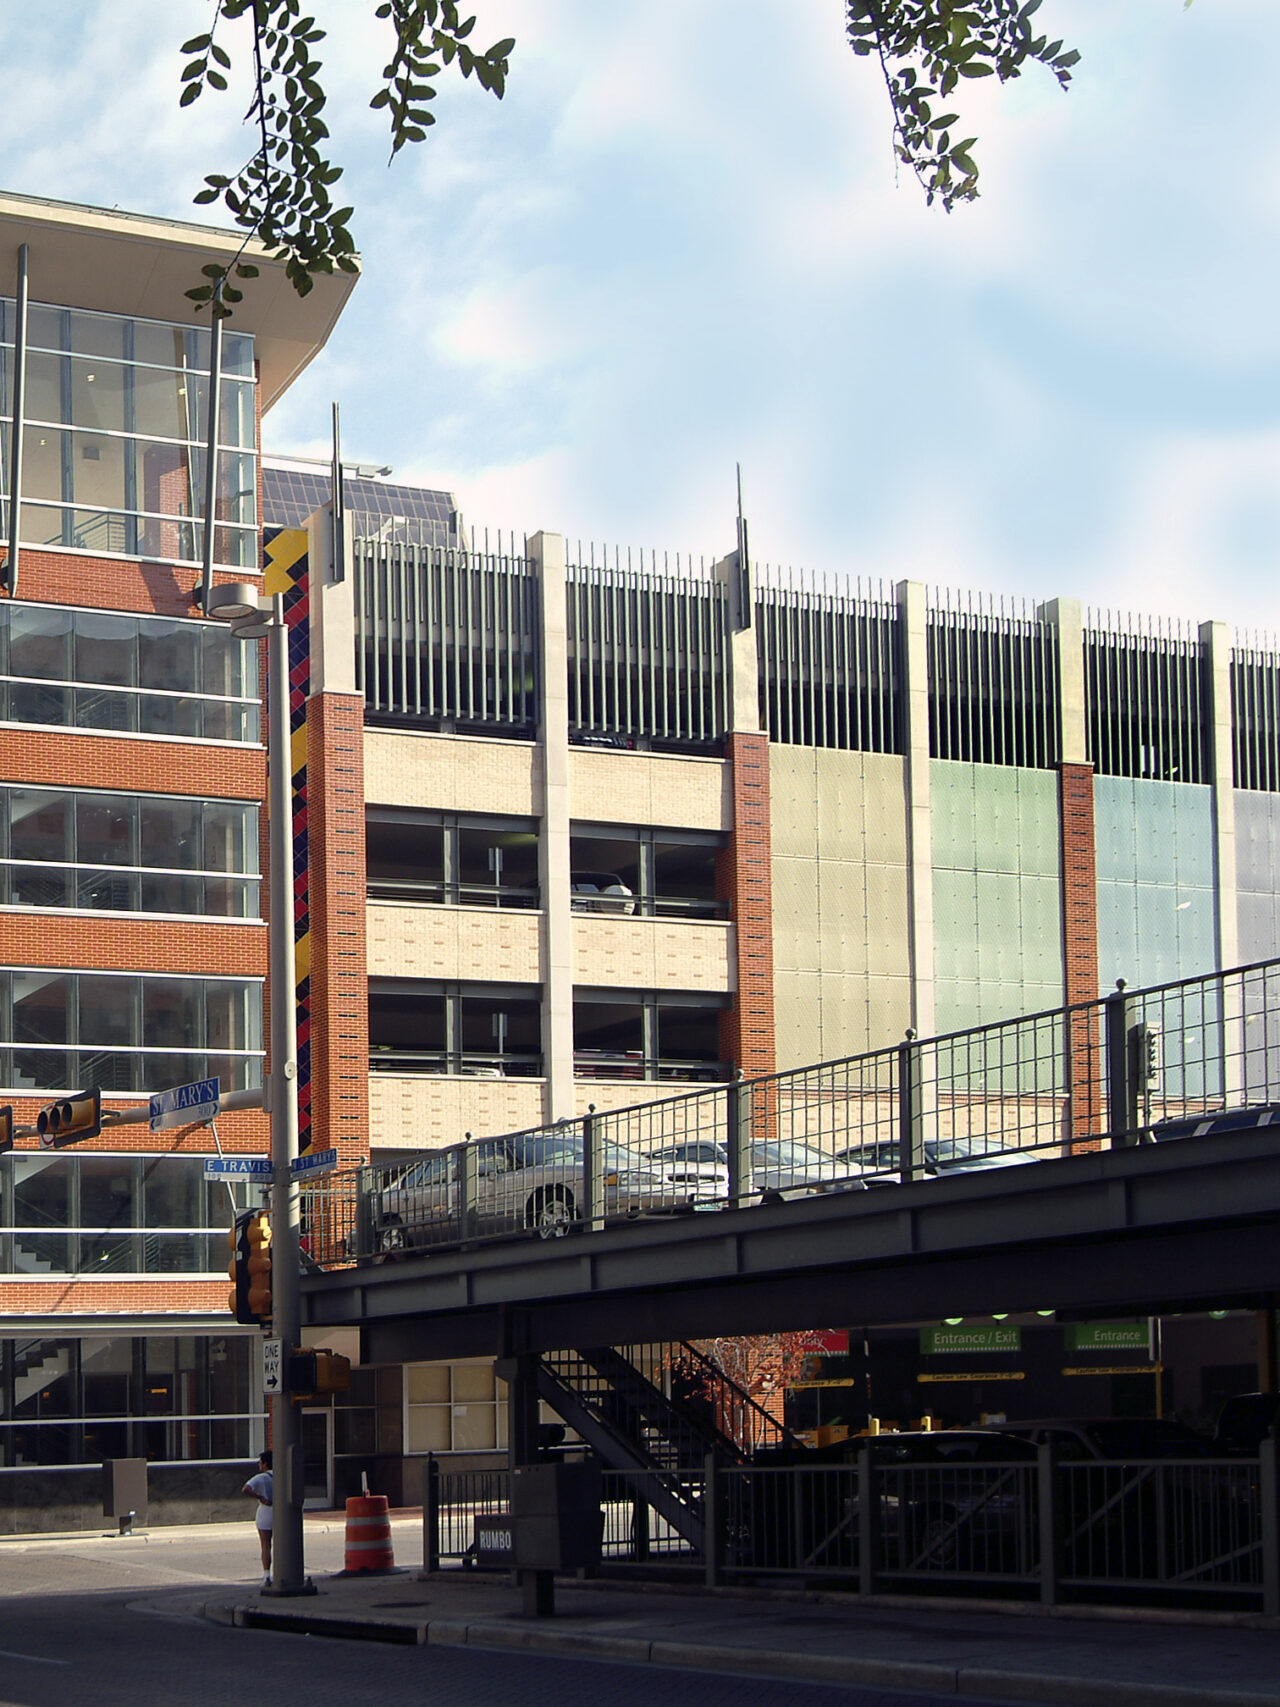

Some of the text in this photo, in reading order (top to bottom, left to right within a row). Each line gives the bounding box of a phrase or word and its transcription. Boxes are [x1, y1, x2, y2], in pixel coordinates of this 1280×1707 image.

[169, 1081, 214, 1111] MARY'S
[207, 1161, 270, 1172] E TRAVIS
[934, 1332, 985, 1344] Entrance
[995, 1331, 1017, 1343] Exit
[1094, 1330, 1141, 1341] Entrance
[265, 1344, 279, 1358] ONE
[264, 1360, 279, 1374] WAY
[480, 1531, 511, 1549] RUMBO
